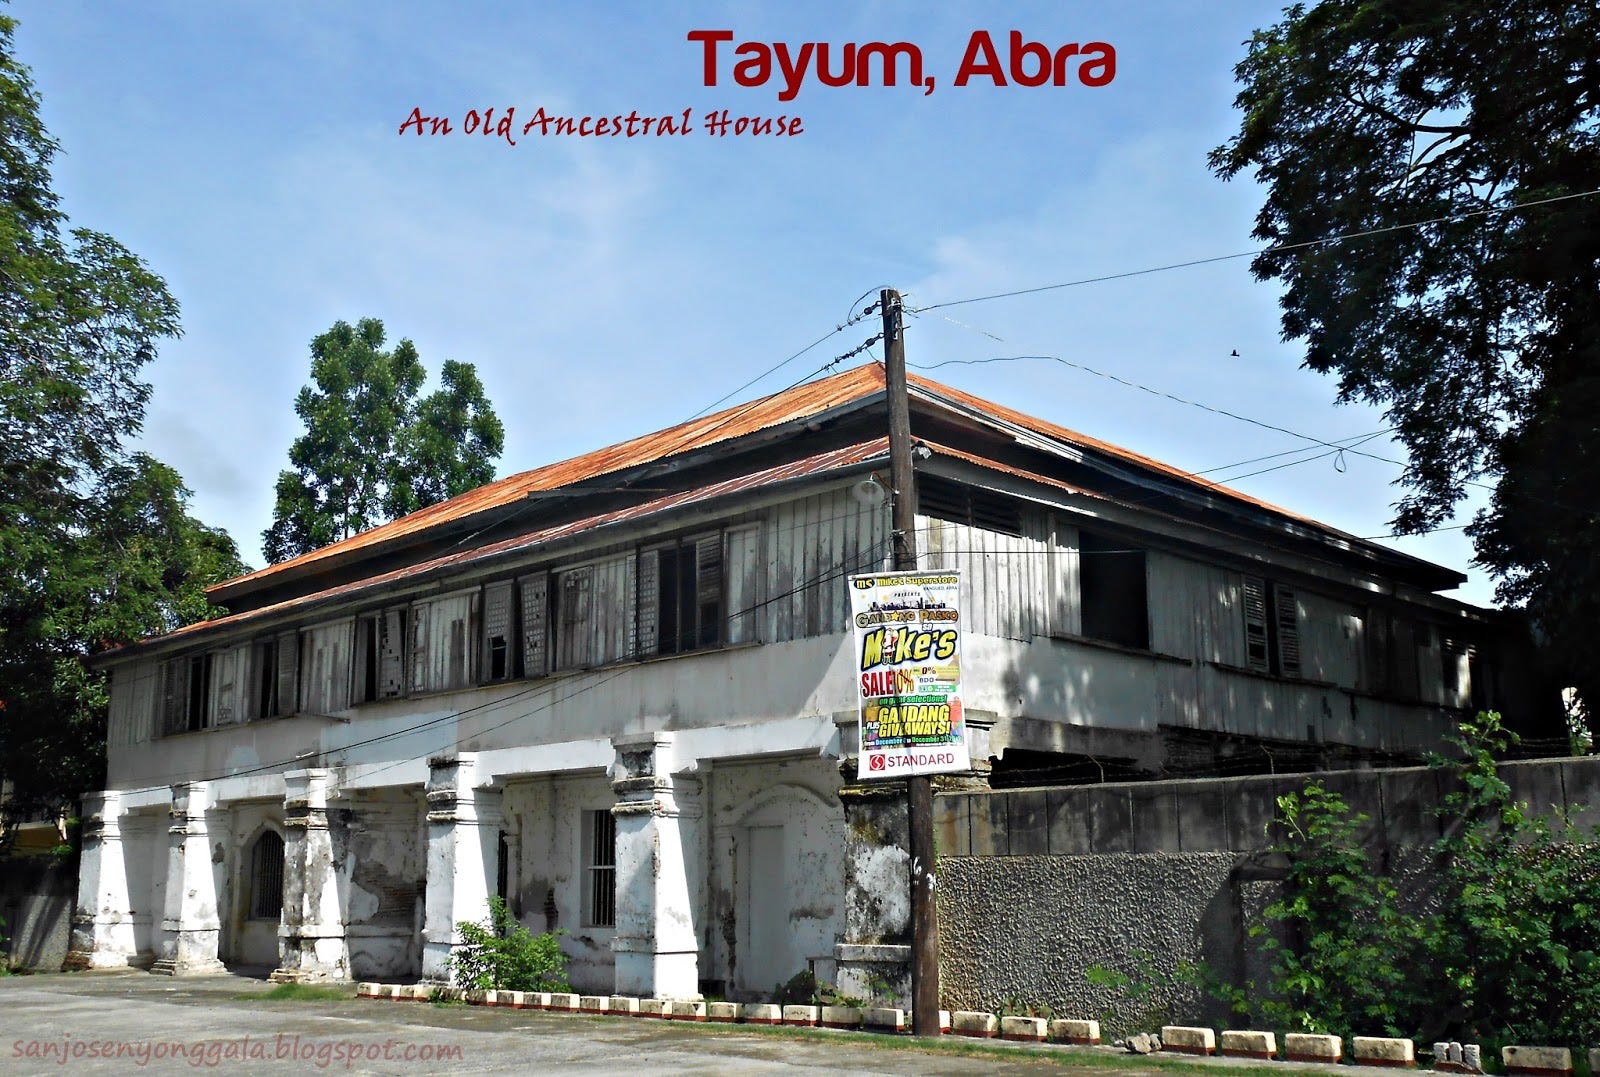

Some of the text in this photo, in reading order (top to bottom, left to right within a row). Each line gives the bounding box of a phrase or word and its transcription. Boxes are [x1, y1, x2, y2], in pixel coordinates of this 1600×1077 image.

[906, 575, 958, 586] Superstore
[862, 671, 894, 698] SALE
[879, 705, 950, 724] GANDANG
[888, 753, 954, 767] STANDARD
